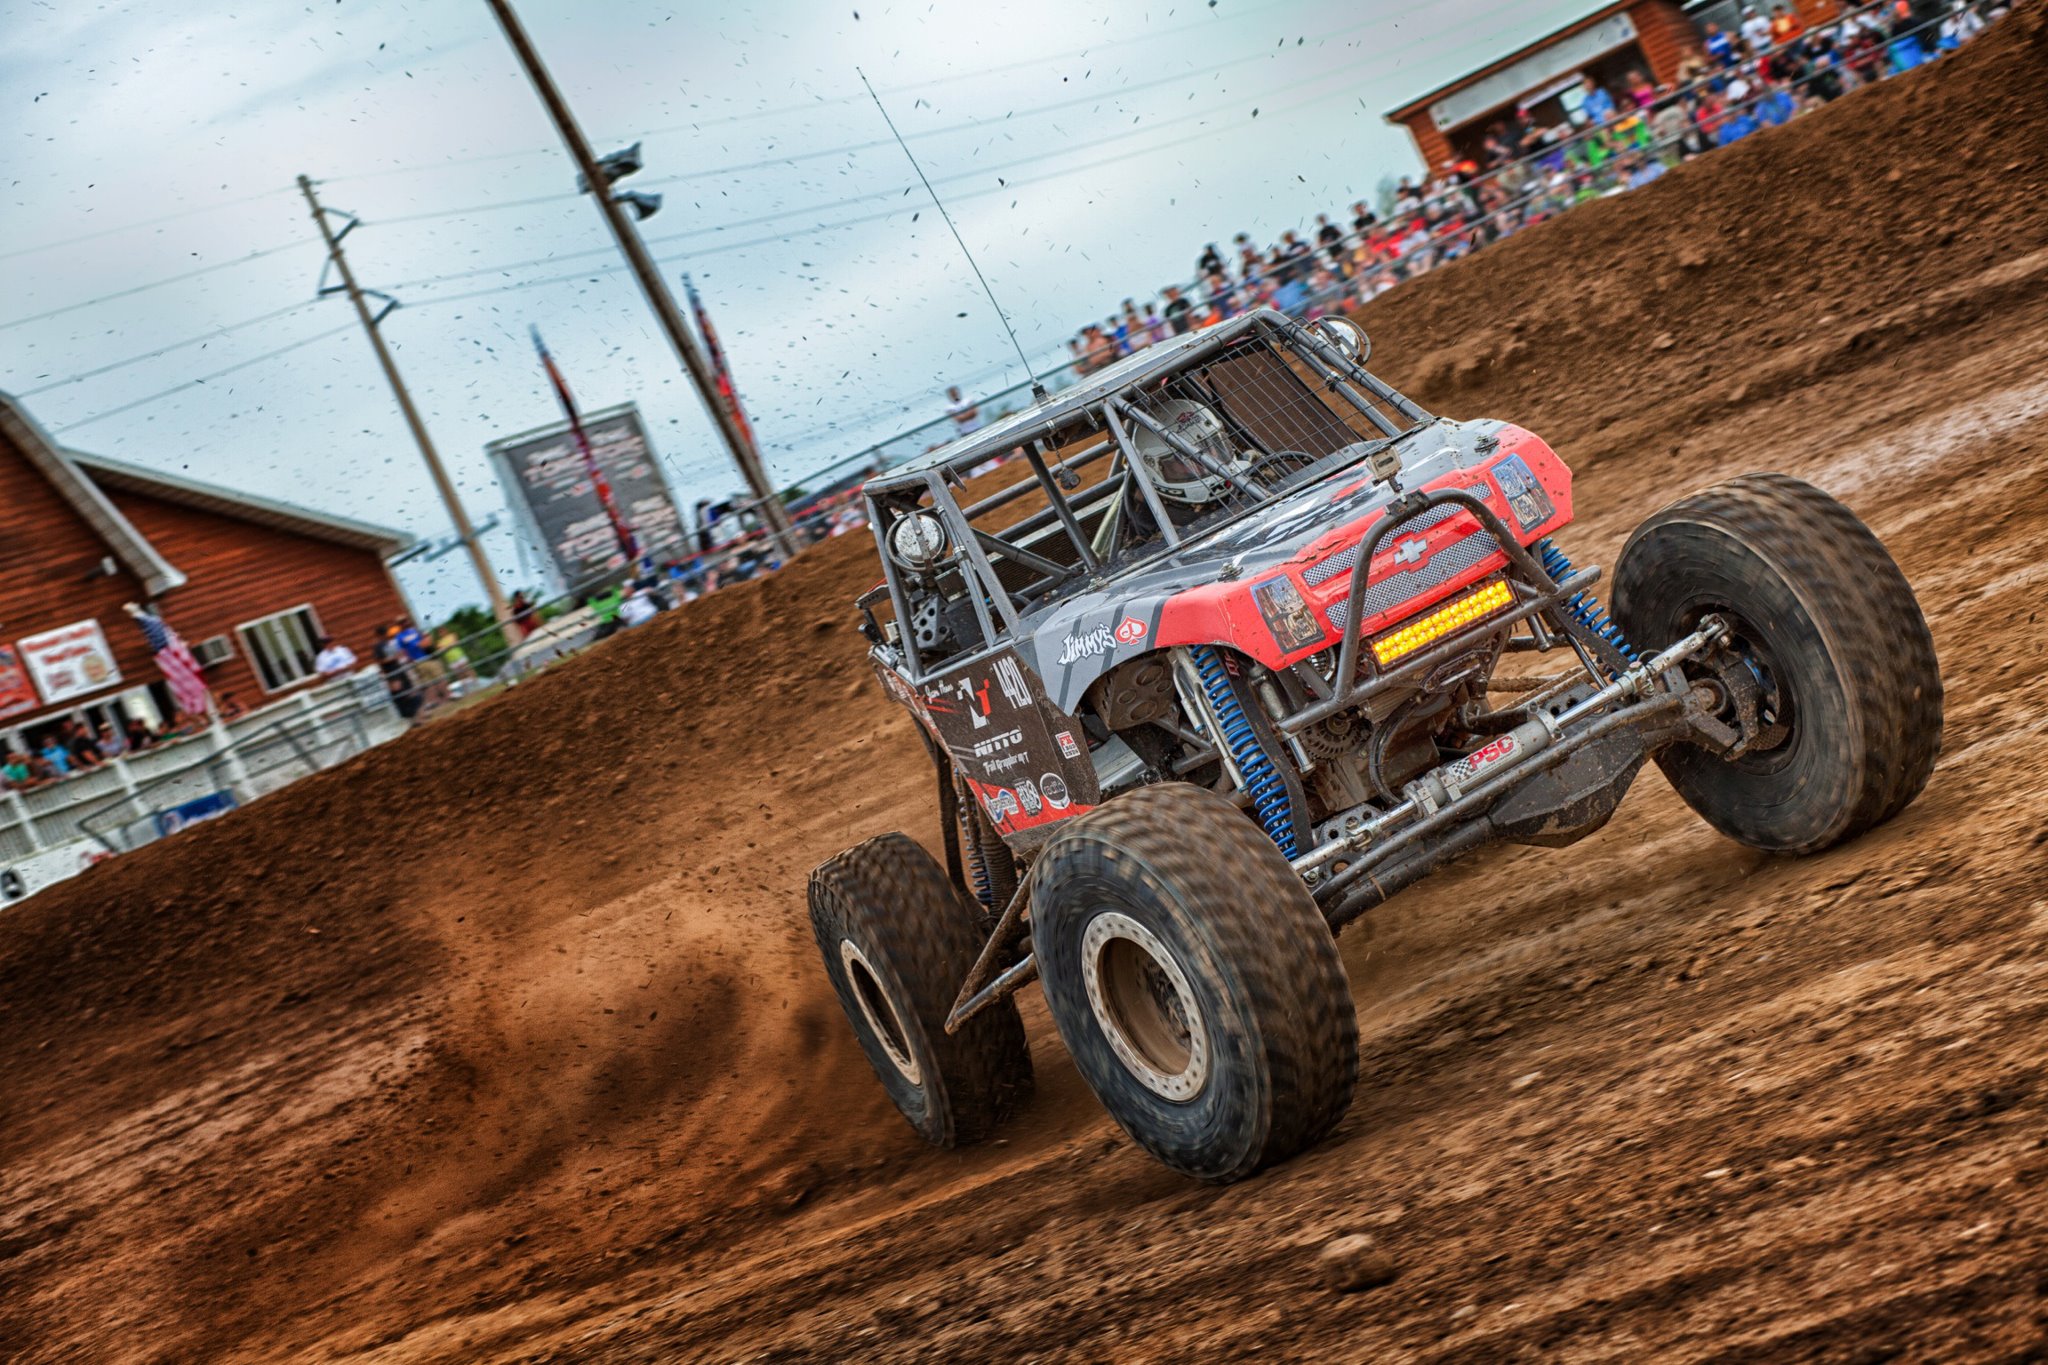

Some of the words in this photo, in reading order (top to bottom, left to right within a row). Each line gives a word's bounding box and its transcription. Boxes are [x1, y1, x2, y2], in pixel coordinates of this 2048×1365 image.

[992, 655, 1032, 709] 4420
[974, 728, 1023, 758] NITTO
[1468, 735, 1515, 770] PSC
